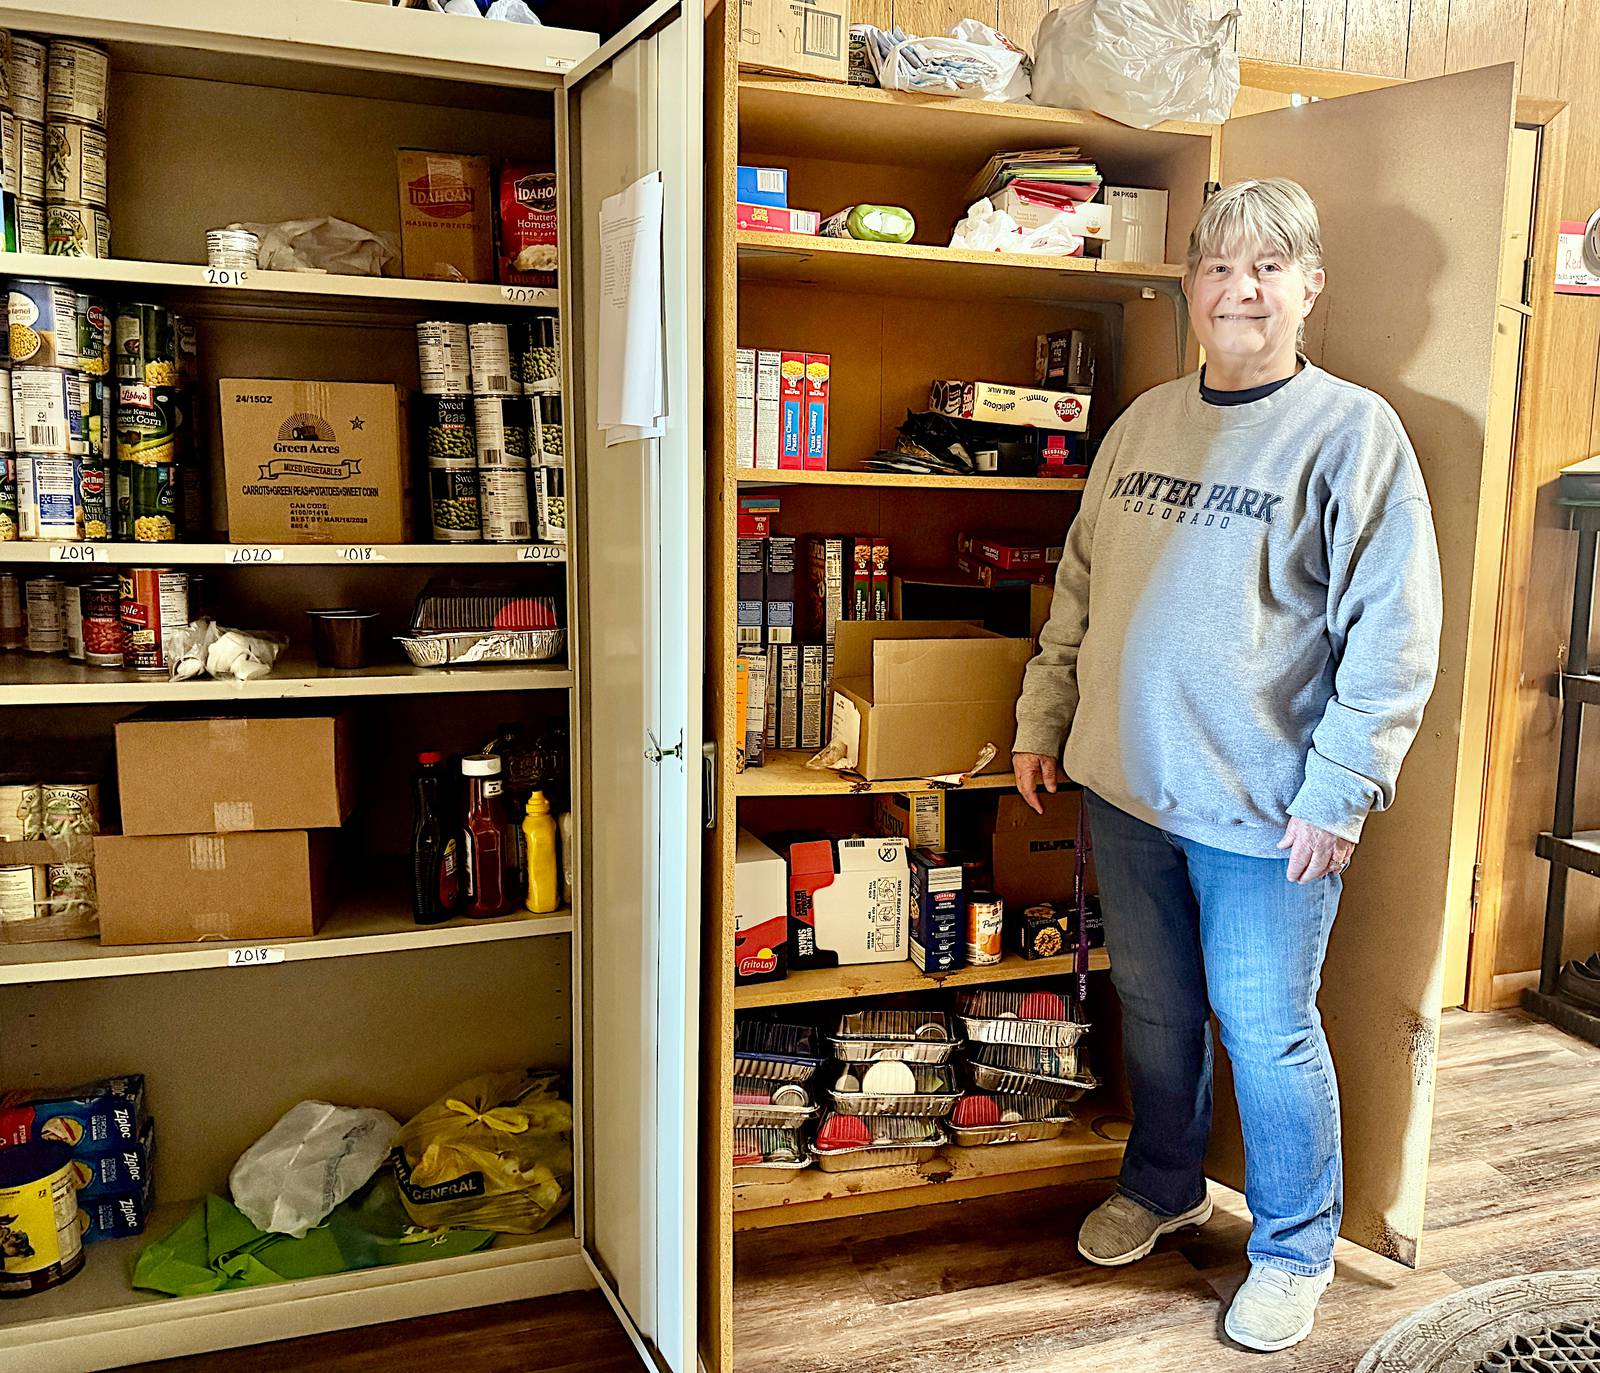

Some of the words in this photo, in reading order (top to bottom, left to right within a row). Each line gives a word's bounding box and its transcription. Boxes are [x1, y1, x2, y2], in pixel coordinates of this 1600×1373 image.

[411, 188, 472, 204] IDAHOAN
[518, 186, 556, 201] IDAHO
[1121, 191, 1138, 199] PKGS
[517, 219, 557, 230] Homesty
[122, 389, 147, 401] Libby's
[987, 386, 1002, 394] MILK
[1003, 388, 1016, 396] REAL
[438, 400, 464, 410] Sweet
[983, 399, 1016, 411] delicious
[133, 408, 157, 417] Kernel
[438, 410, 466, 423] Peas
[136, 415, 162, 427] Corn
[273, 442, 308, 454] Green
[309, 442, 340, 454] Acres
[283, 463, 303, 473] MIXED
[303, 464, 343, 477] VEGETABLES
[362, 487, 379, 498] CORN
[1203, 482, 1283, 524] PARK
[1123, 499, 1231, 530] COLORADO
[60, 547, 95, 561] 2019
[233, 549, 272, 563] 2020
[523, 547, 560, 559] 2020
[120, 603, 138, 615] tyle
[982, 919, 1003, 932] Pump
[806, 927, 814, 940] ONE
[797, 928, 807, 957] SNACK
[806, 941, 814, 956] EPIC
[234, 949, 268, 963] 2018
[113, 1108, 131, 1138] Ziploc
[123, 1151, 141, 1181] Ziploc
[412, 1178, 478, 1201] GENERAL
[119, 1198, 138, 1228] Ziploc
